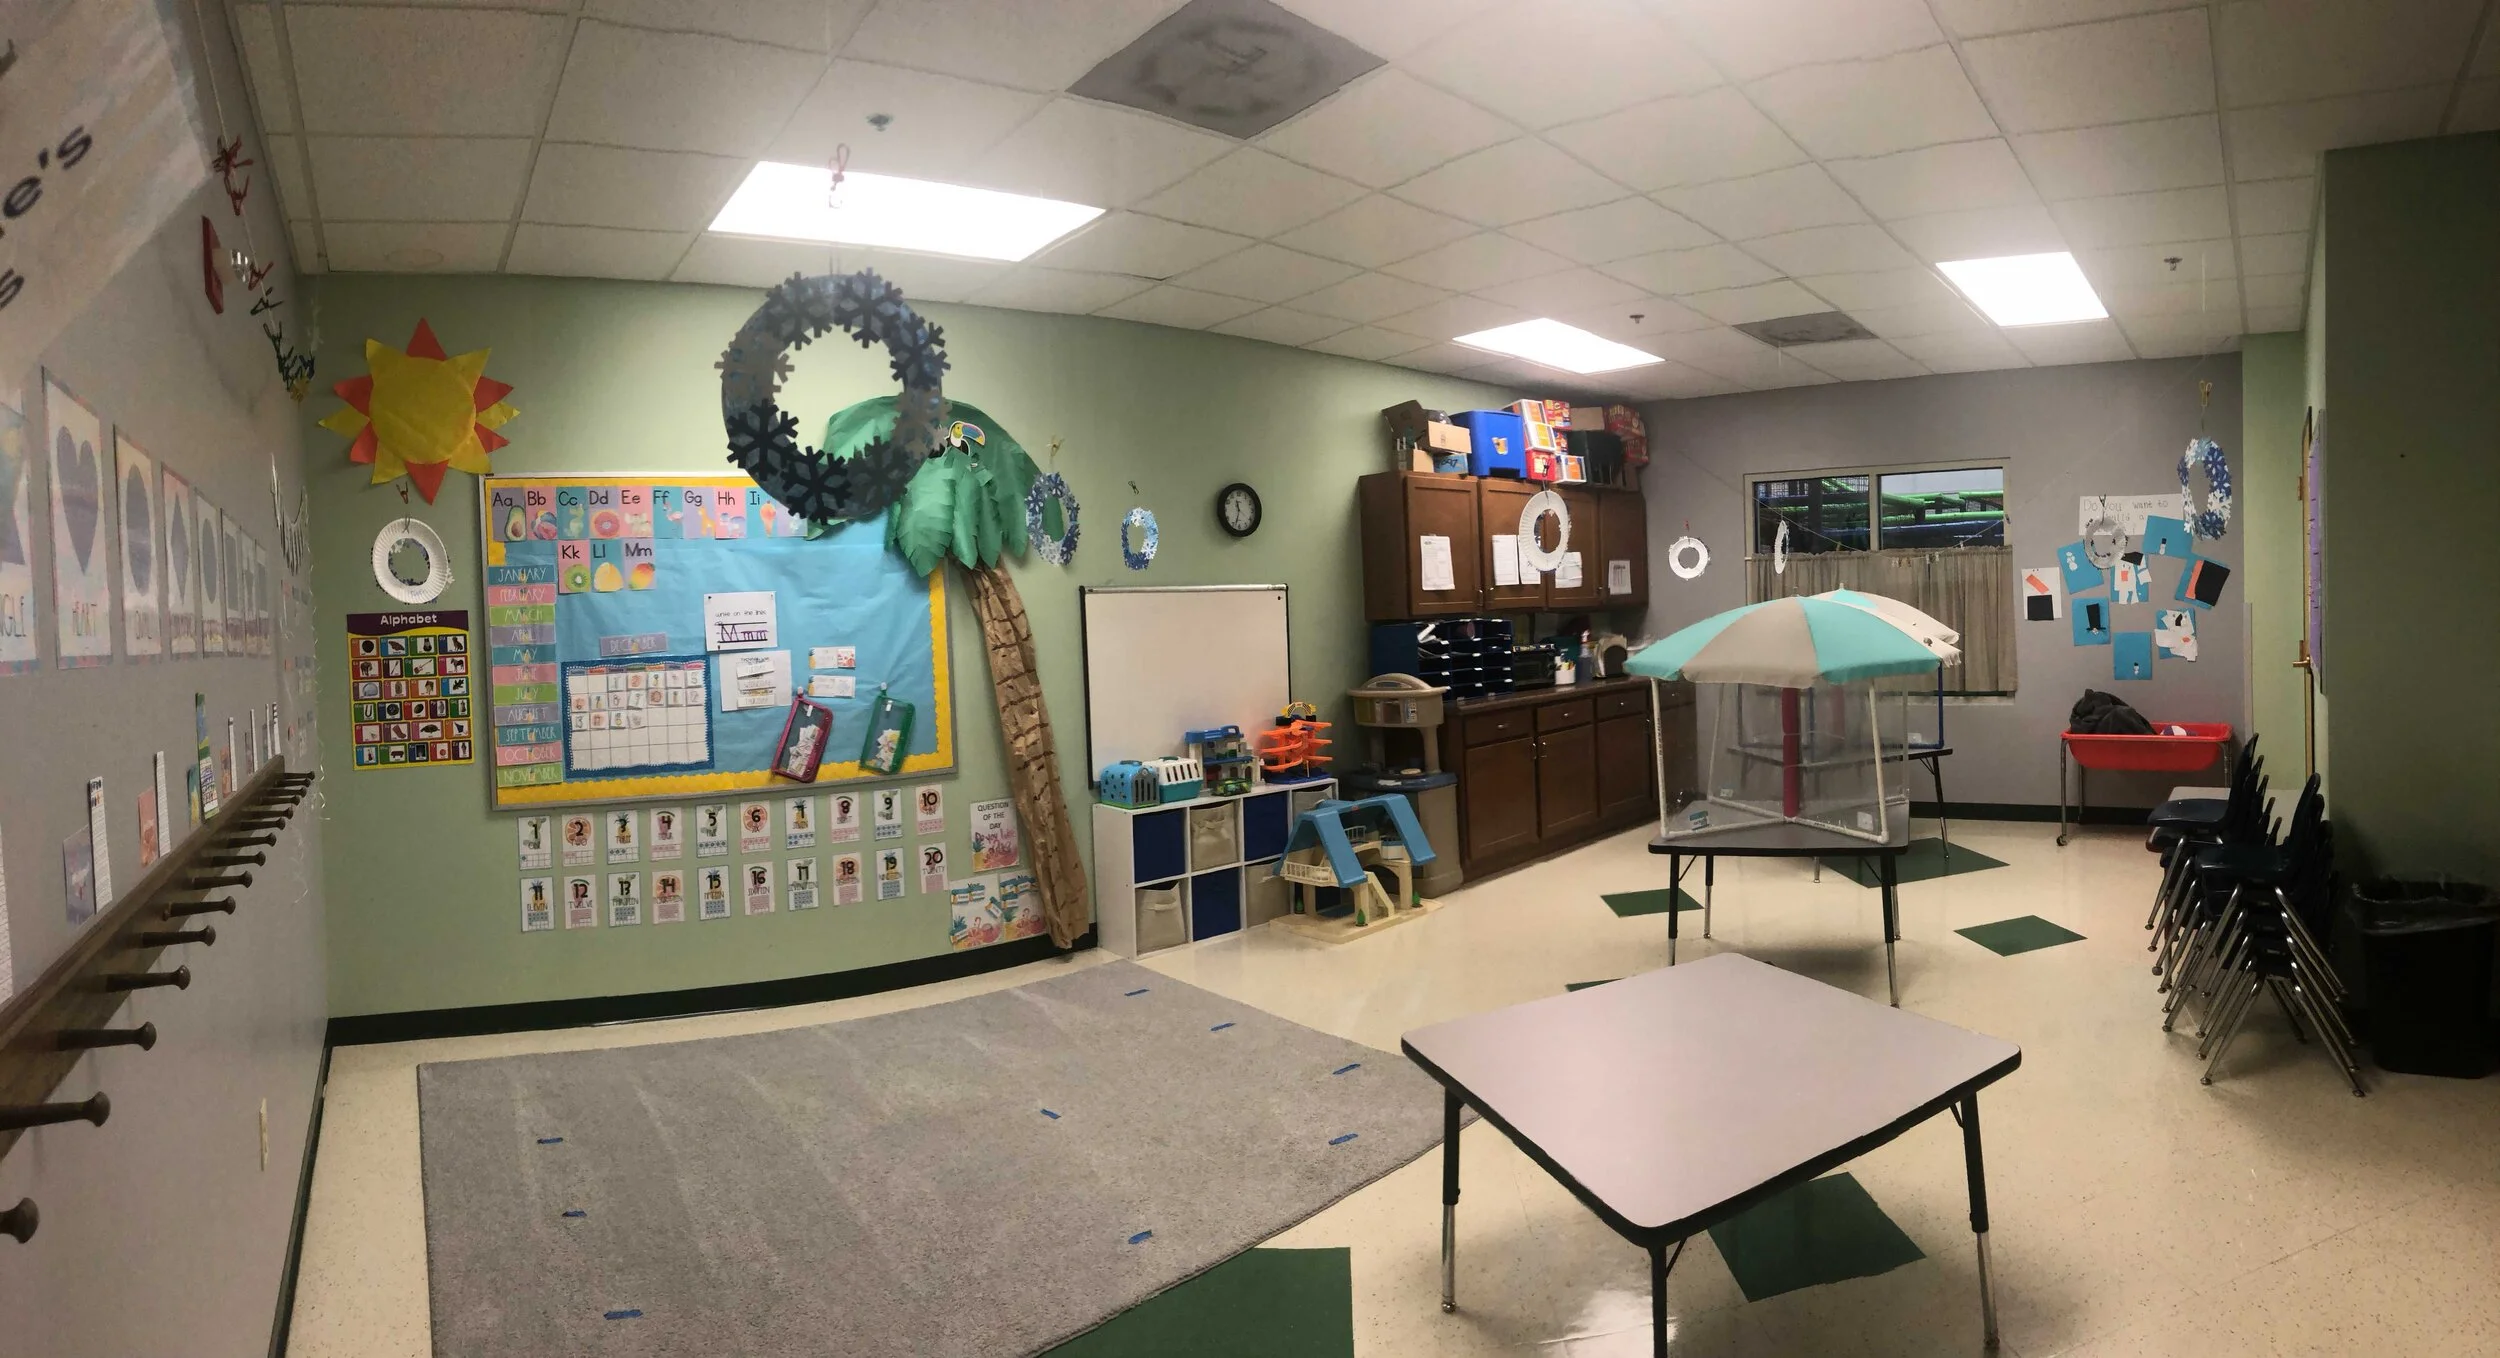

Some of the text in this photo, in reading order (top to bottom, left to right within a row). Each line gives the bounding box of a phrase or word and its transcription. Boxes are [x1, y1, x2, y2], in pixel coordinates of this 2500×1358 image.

[0, 125, 93, 240] e's
[493, 490, 760, 507] Aa Bb Cc Dd Ee Ff Gg Hh Ii
[2084, 499, 2098, 511] Do
[2132, 500, 2153, 510] want
[2157, 499, 2168, 508] to
[561, 543, 652, 560] Kk Ll Mm
[498, 567, 546, 582] JANUARY
[380, 613, 438, 627] Alphabet
[513, 648, 538, 661] MAY
[507, 706, 549, 722] AUGUST
[506, 726, 556, 742] SEPTEMBER
[504, 747, 556, 762] OCTOBER
[504, 767, 557, 783] NOVEMBER
[840, 800, 851, 814] 8
[884, 797, 893, 810] 9
[922, 792, 938, 807] 10
[977, 801, 1009, 812] QUESTION
[709, 812, 717, 827] 5
[751, 809, 761, 823] 6
[982, 811, 1005, 821] OF THE
[532, 824, 539, 839] 1
[575, 821, 584, 837] 2
[989, 821, 1002, 830] DAY
[883, 856, 898, 872] 19
[924, 850, 944, 866] 20
[840, 860, 855, 876] 18
[660, 878, 676, 894] 14
[707, 874, 722, 890] 15
[751, 870, 766, 886] 16
[533, 885, 543, 901] 11
[573, 883, 588, 899] 12
[618, 880, 632, 896] 13
